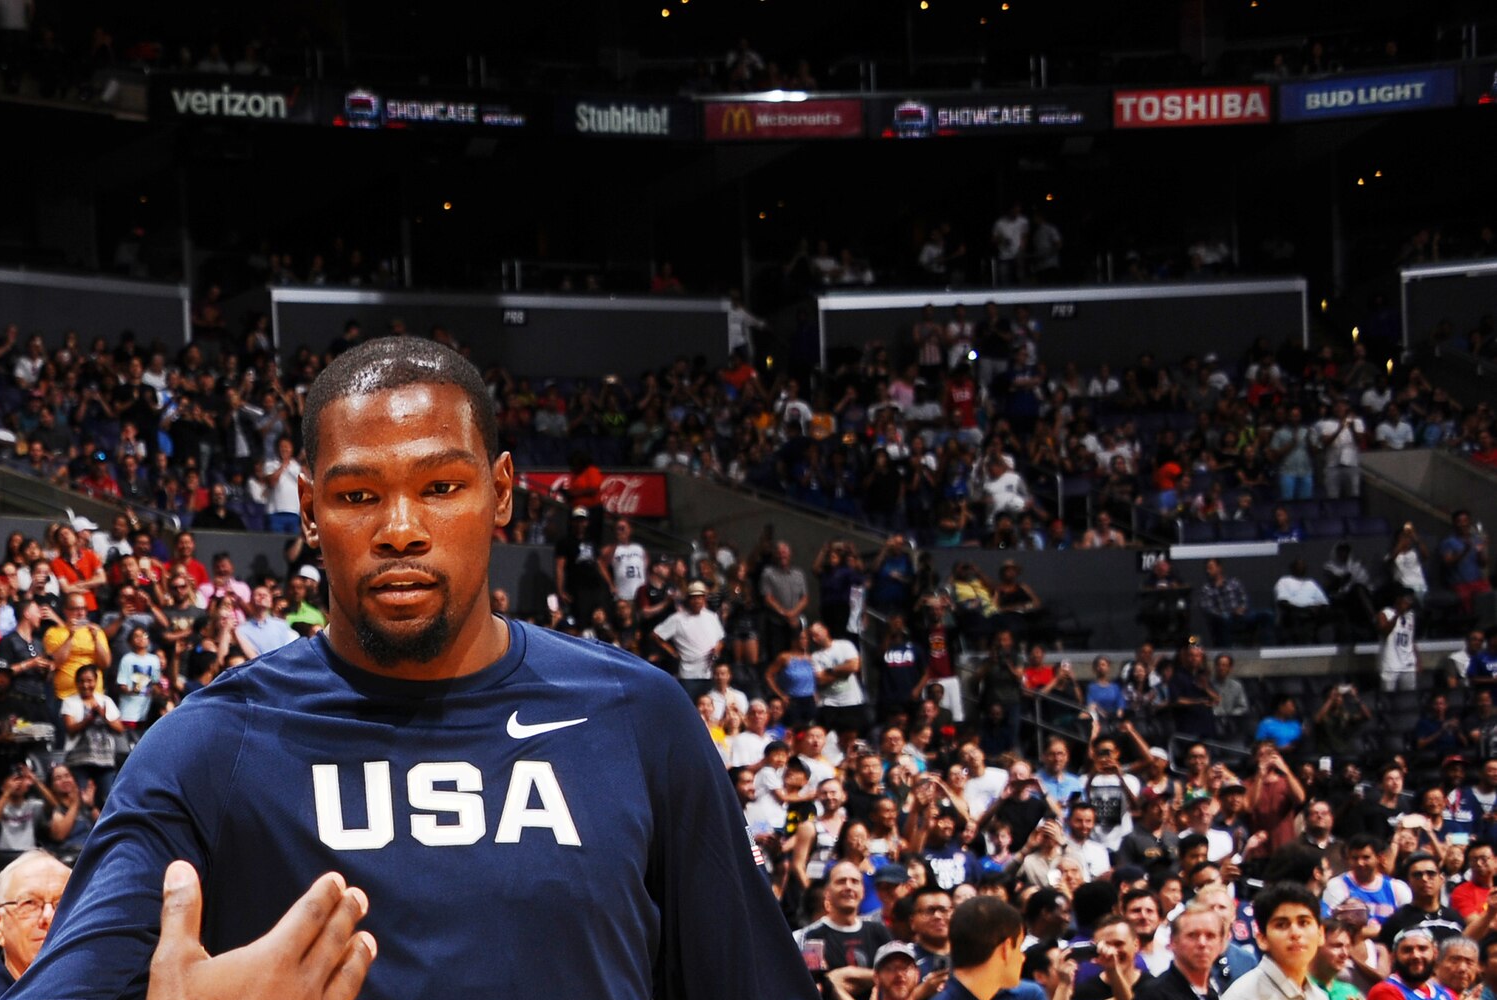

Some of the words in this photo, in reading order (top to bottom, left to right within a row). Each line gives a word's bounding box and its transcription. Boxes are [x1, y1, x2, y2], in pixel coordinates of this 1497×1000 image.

[170, 83, 287, 118] verizon
[1117, 92, 1267, 122] TOSHIBA
[1305, 90, 1354, 110] BUD
[1358, 82, 1426, 103] LIGHT
[386, 99, 477, 123] SHOWCASE
[575, 102, 669, 135] StubHub!
[756, 112, 842, 127] McDonald's
[938, 105, 1032, 126] SHOWCASE
[312, 760, 582, 851] USA
